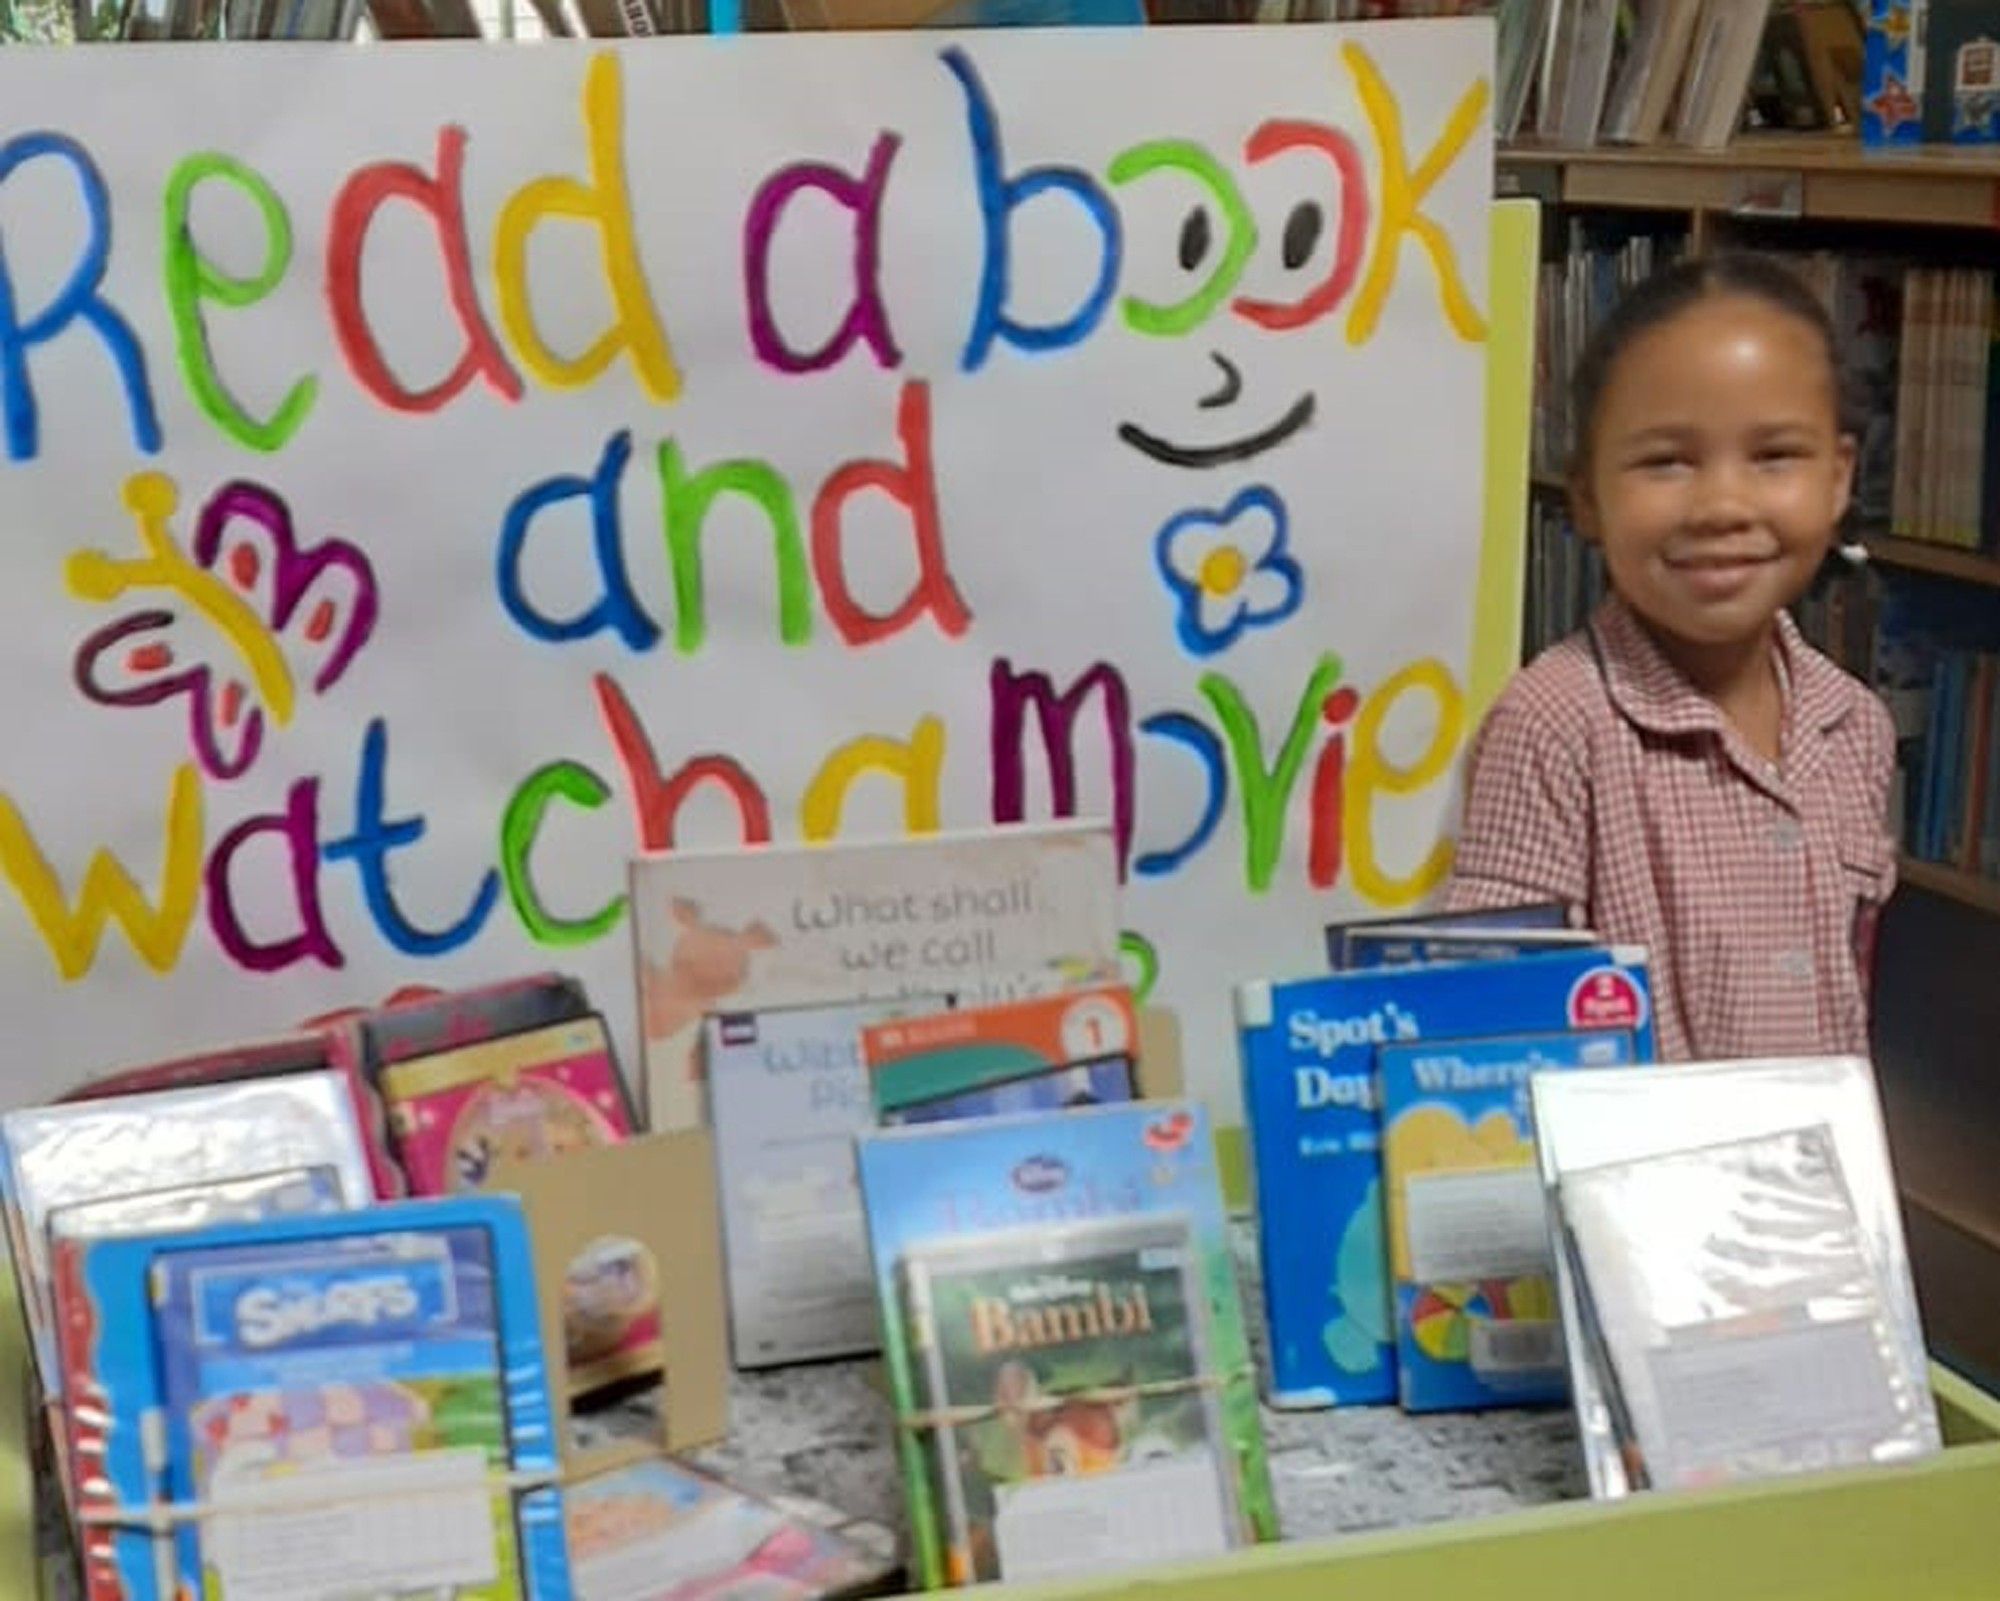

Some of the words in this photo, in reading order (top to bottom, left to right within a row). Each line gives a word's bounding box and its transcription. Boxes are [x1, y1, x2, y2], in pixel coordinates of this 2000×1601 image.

[0, 50, 684, 462] Read
[743, 130, 903, 374] a
[939, 40, 1490, 372] book
[497, 380, 973, 650] and
[990, 650, 1466, 908] movie
[792, 890, 922, 931] What
[931, 878, 1032, 923] shall
[840, 939, 907, 972] we
[922, 929, 996, 967] call
[1288, 1001, 1420, 1058] Spot's
[969, 1279, 1153, 1353] Bambi
